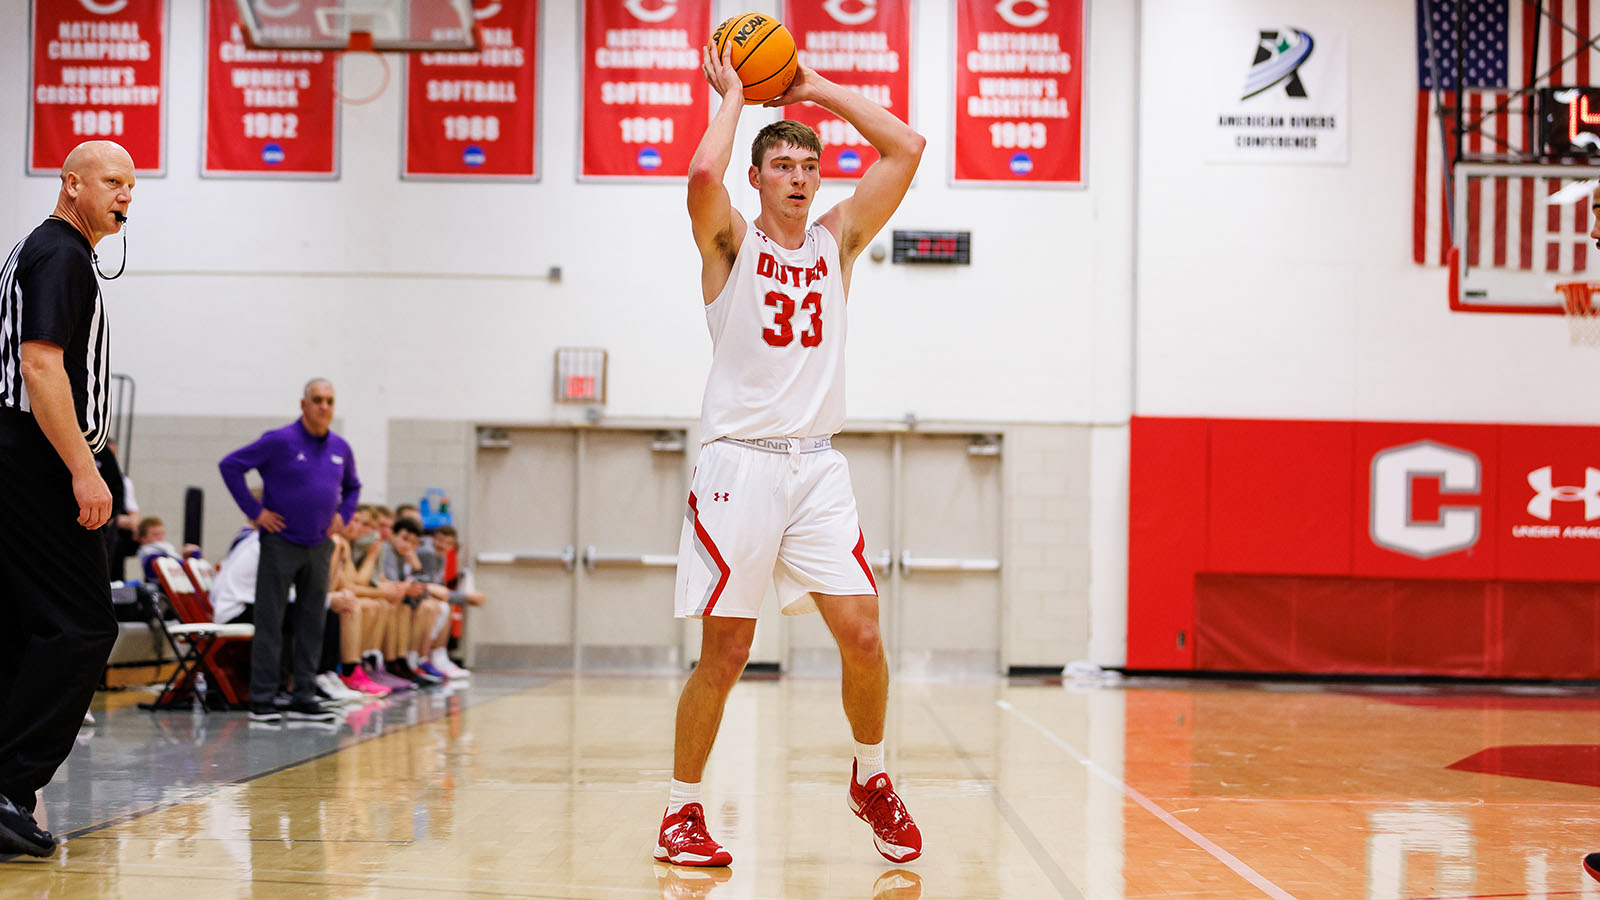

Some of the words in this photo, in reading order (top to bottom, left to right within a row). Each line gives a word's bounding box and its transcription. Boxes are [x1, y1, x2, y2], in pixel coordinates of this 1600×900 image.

[58, 22, 139, 40] NATIONAL
[606, 29, 690, 48] NATIONAL
[733, 15, 768, 48] NCAA
[805, 31, 888, 51] NATIONAL
[48, 41, 150, 60] CHAMPIONS
[978, 33, 1061, 51] NATIONAL
[595, 48, 700, 69] CHAMPIONS
[967, 51, 1071, 73] CHAMPIONS
[62, 67, 135, 85] WOMEN'S
[231, 69, 310, 88] WOMEN'S
[36, 85, 87, 104] CROSS
[90, 86, 159, 105] COUNTRY
[243, 88, 299, 107] TRACK
[426, 80, 517, 102] SOFTBALL
[601, 82, 693, 105] SOFTBALL
[979, 78, 1058, 97] WOMEN'S
[968, 96, 1070, 118] BASKETBALL
[72, 111, 123, 136] 1981
[243, 112, 299, 138] 1982
[818, 119, 873, 146] 199
[989, 122, 1047, 148] 1993
[761, 291, 823, 348] 33
[1370, 439, 1481, 560] C
[1512, 525, 1561, 538] UNDER
